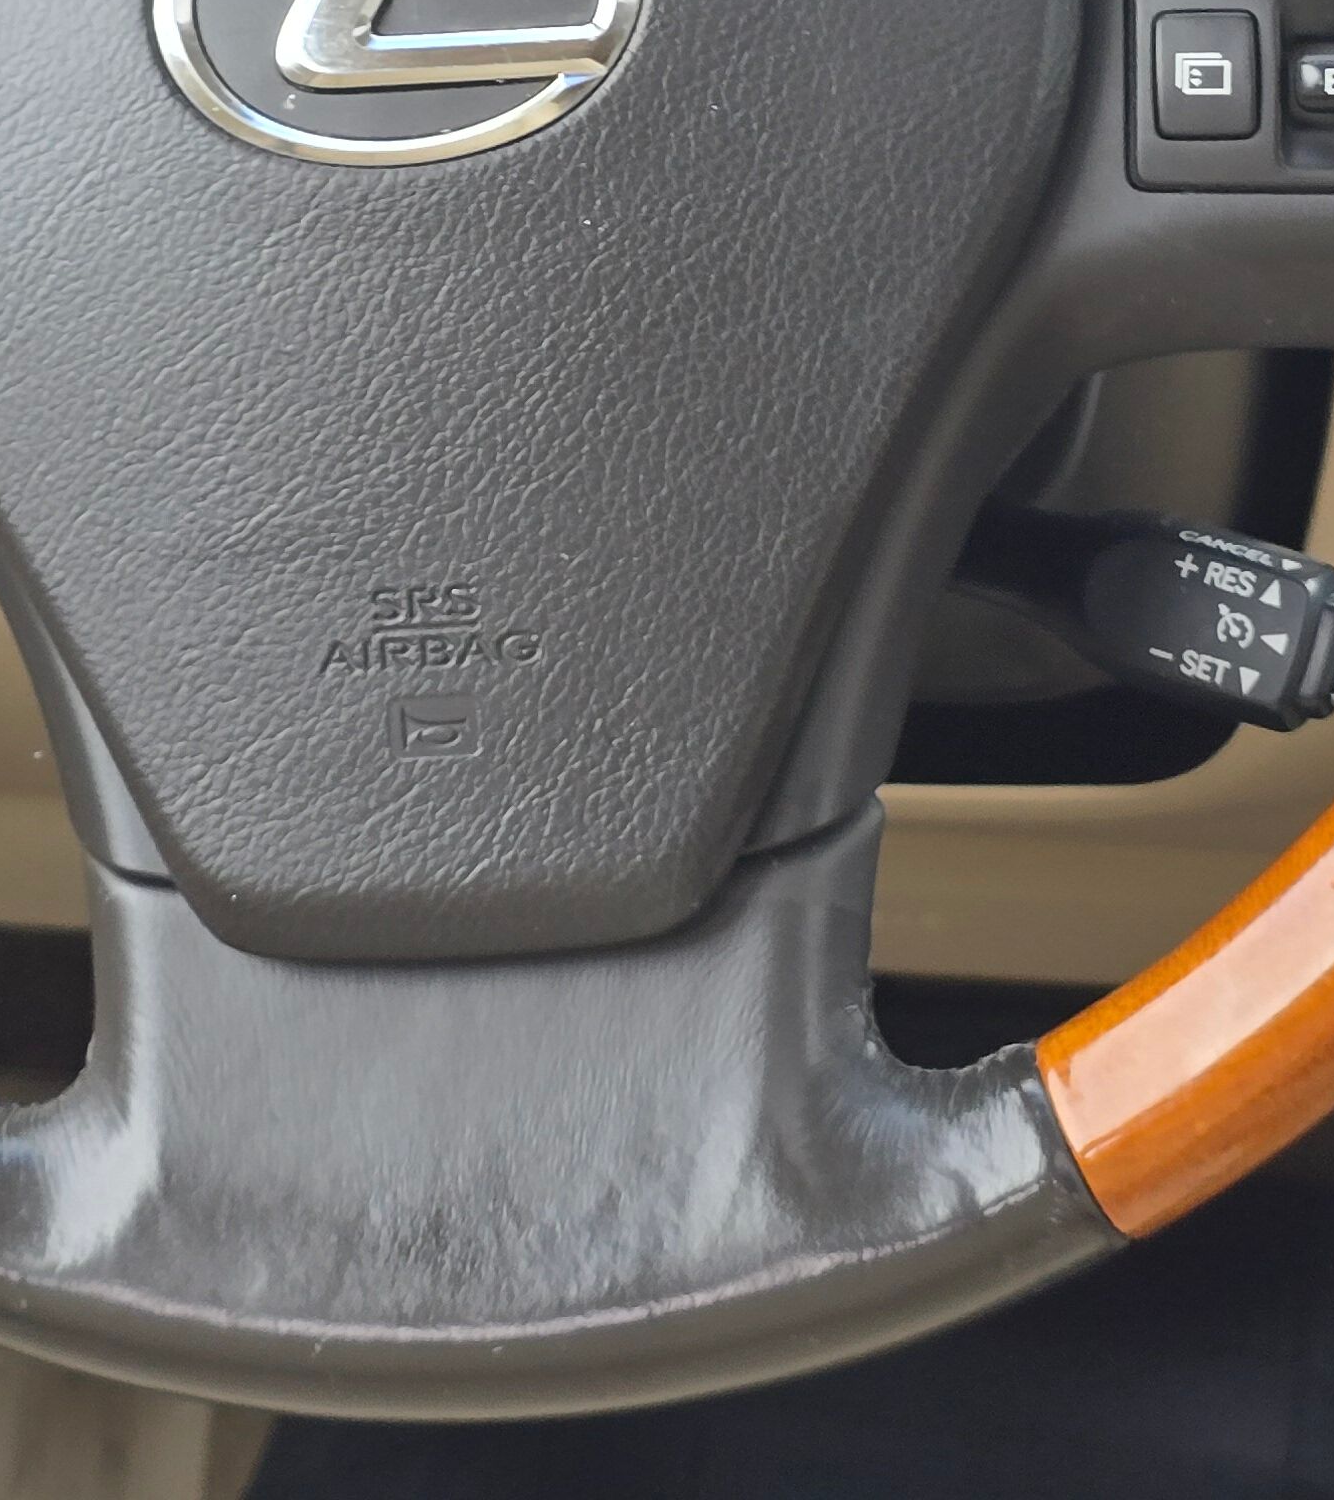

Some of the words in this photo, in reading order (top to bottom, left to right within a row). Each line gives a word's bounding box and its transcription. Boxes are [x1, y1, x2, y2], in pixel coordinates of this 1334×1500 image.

[1179, 530, 1274, 567] CANCEL
[1203, 560, 1258, 598] RES
[370, 586, 482, 624] SRS
[319, 629, 544, 676] AIRBAG
[1179, 649, 1233, 686] SET
